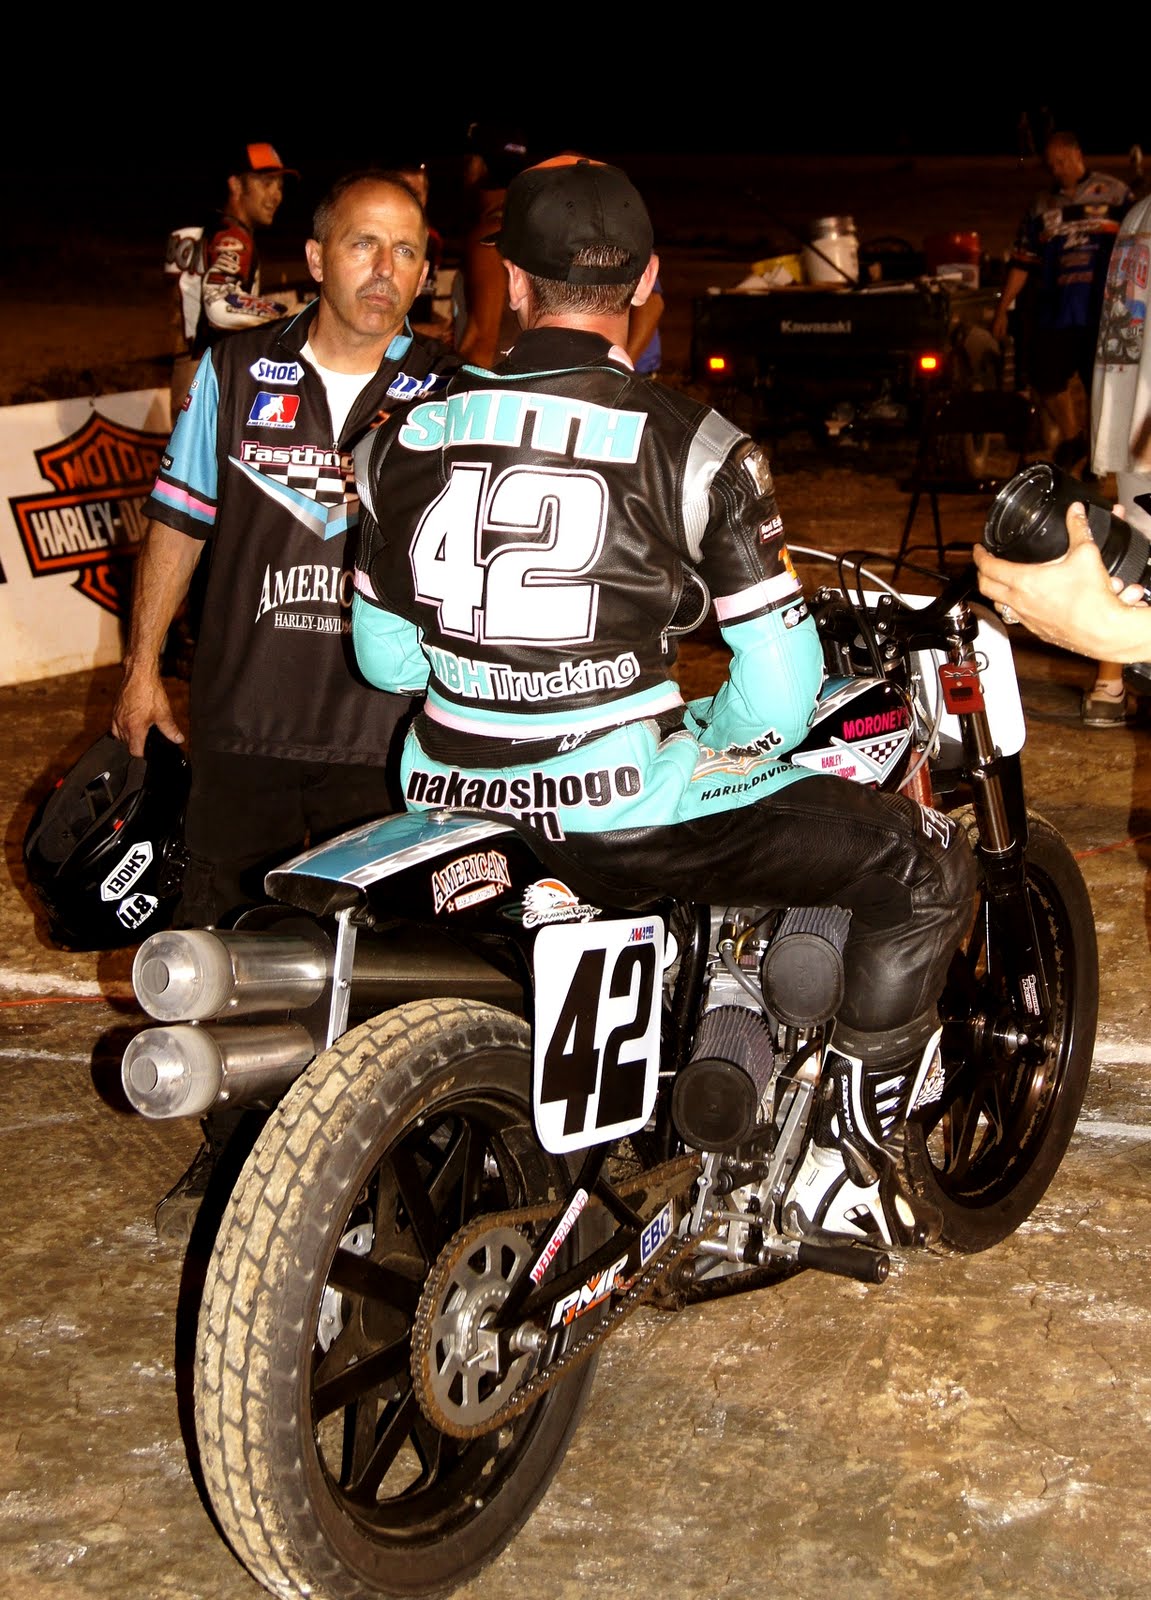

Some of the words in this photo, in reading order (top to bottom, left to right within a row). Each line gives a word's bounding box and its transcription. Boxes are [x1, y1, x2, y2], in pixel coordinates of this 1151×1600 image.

[781, 320, 851, 334] Kawasaki
[398, 389, 648, 464] SMITH
[408, 461, 610, 646] 42
[255, 564, 354, 623] AMERIC
[405, 766, 642, 809] nakaoshogo
[107, 850, 147, 894] SHOEI
[431, 850, 512, 914] AMERICAN
[540, 942, 657, 1137] 42
[641, 1206, 671, 1262] EBC
